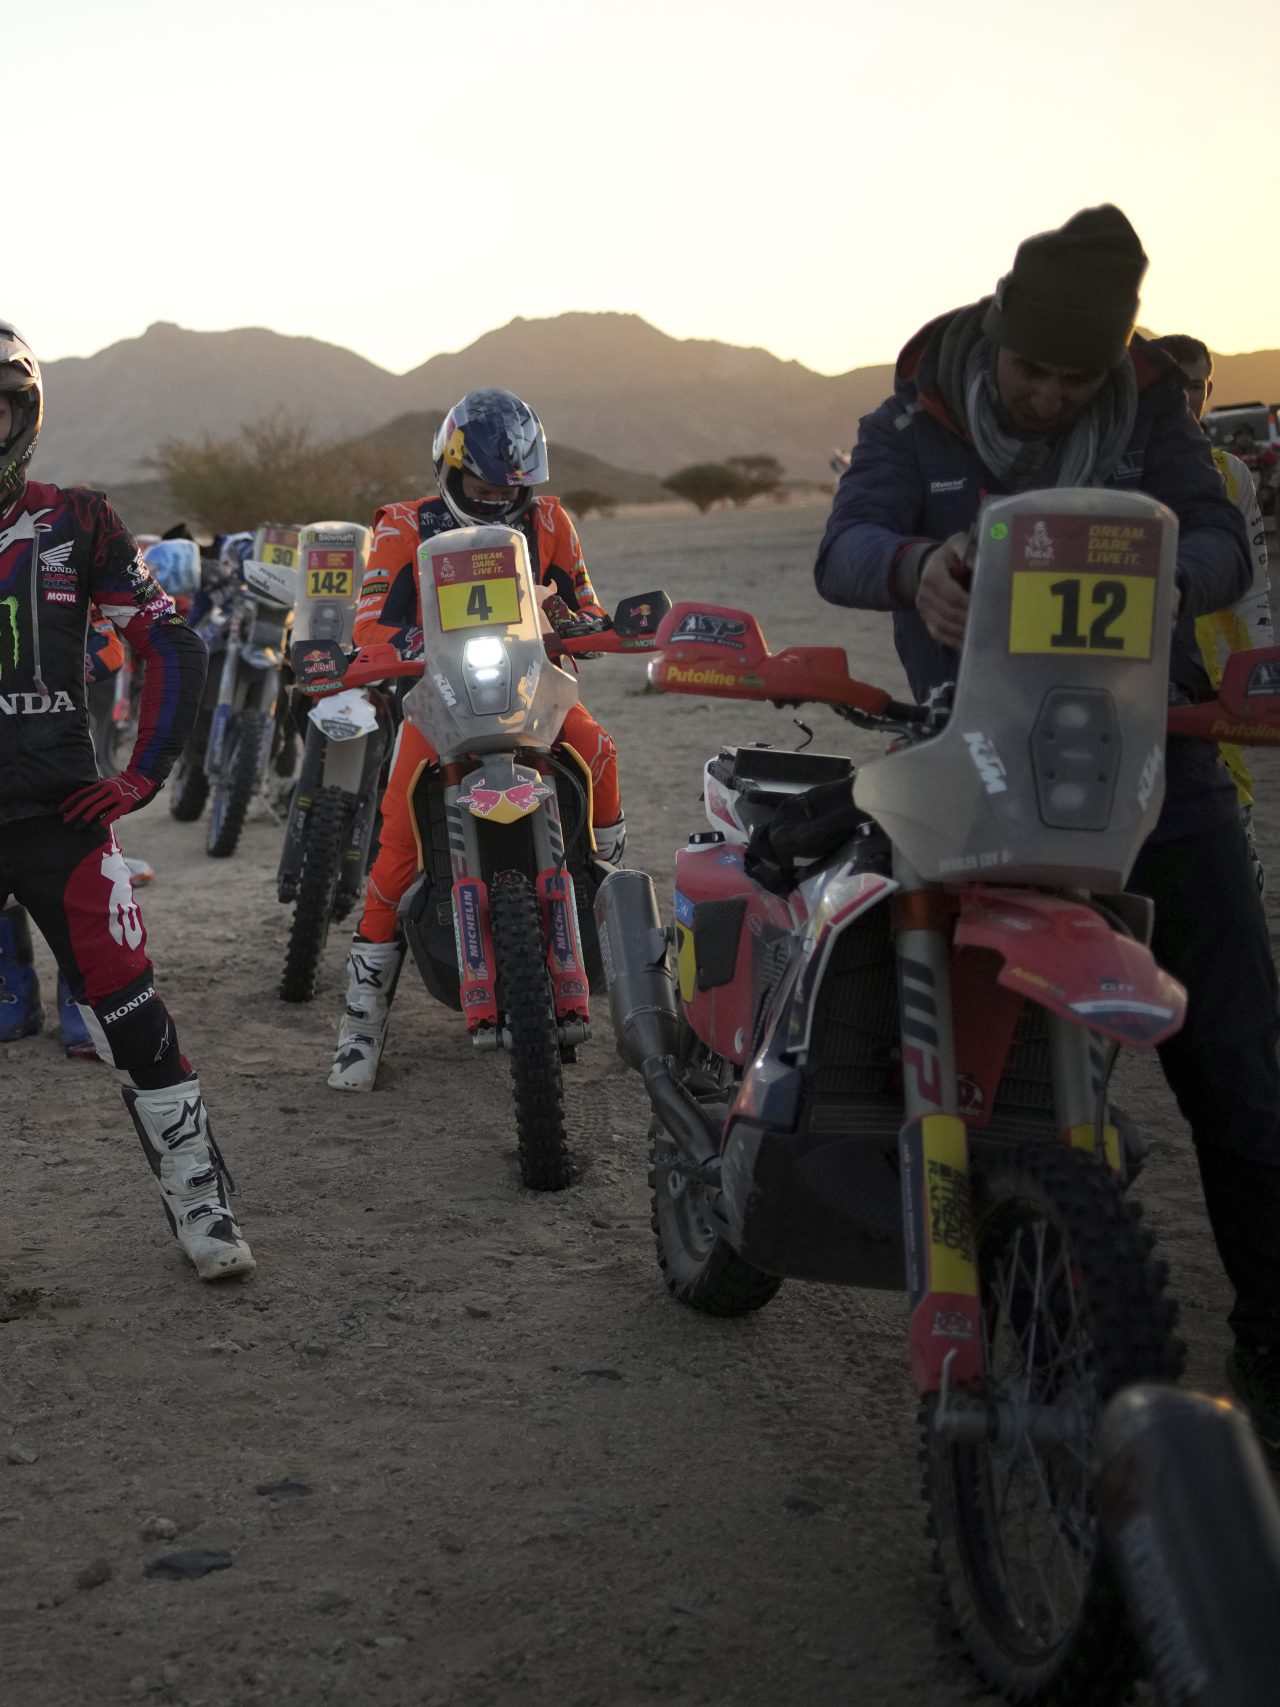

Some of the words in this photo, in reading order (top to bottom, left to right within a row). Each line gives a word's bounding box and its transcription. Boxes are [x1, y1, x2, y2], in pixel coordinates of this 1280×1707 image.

[1088, 524, 1147, 540] DREAM.
[1087, 539, 1134, 551] DARE.
[471, 551, 505, 562] DREAM.
[473, 559, 499, 569] DARE.
[1086, 551, 1122, 564] LIVE
[40, 564, 78, 575] HONDA
[473, 566, 492, 576] LIVE
[311, 571, 348, 594] 142
[46, 591, 77, 603] MOTUL
[466, 584, 493, 621] 4
[1049, 578, 1128, 650] 12
[667, 666, 736, 687] Putoline
[433, 673, 457, 707] KTM
[1212, 718, 1280, 739] Putolin
[961, 731, 1008, 794] KTM
[463, 890, 479, 958] MICHELIN
[103, 986, 156, 1026] HONDA
